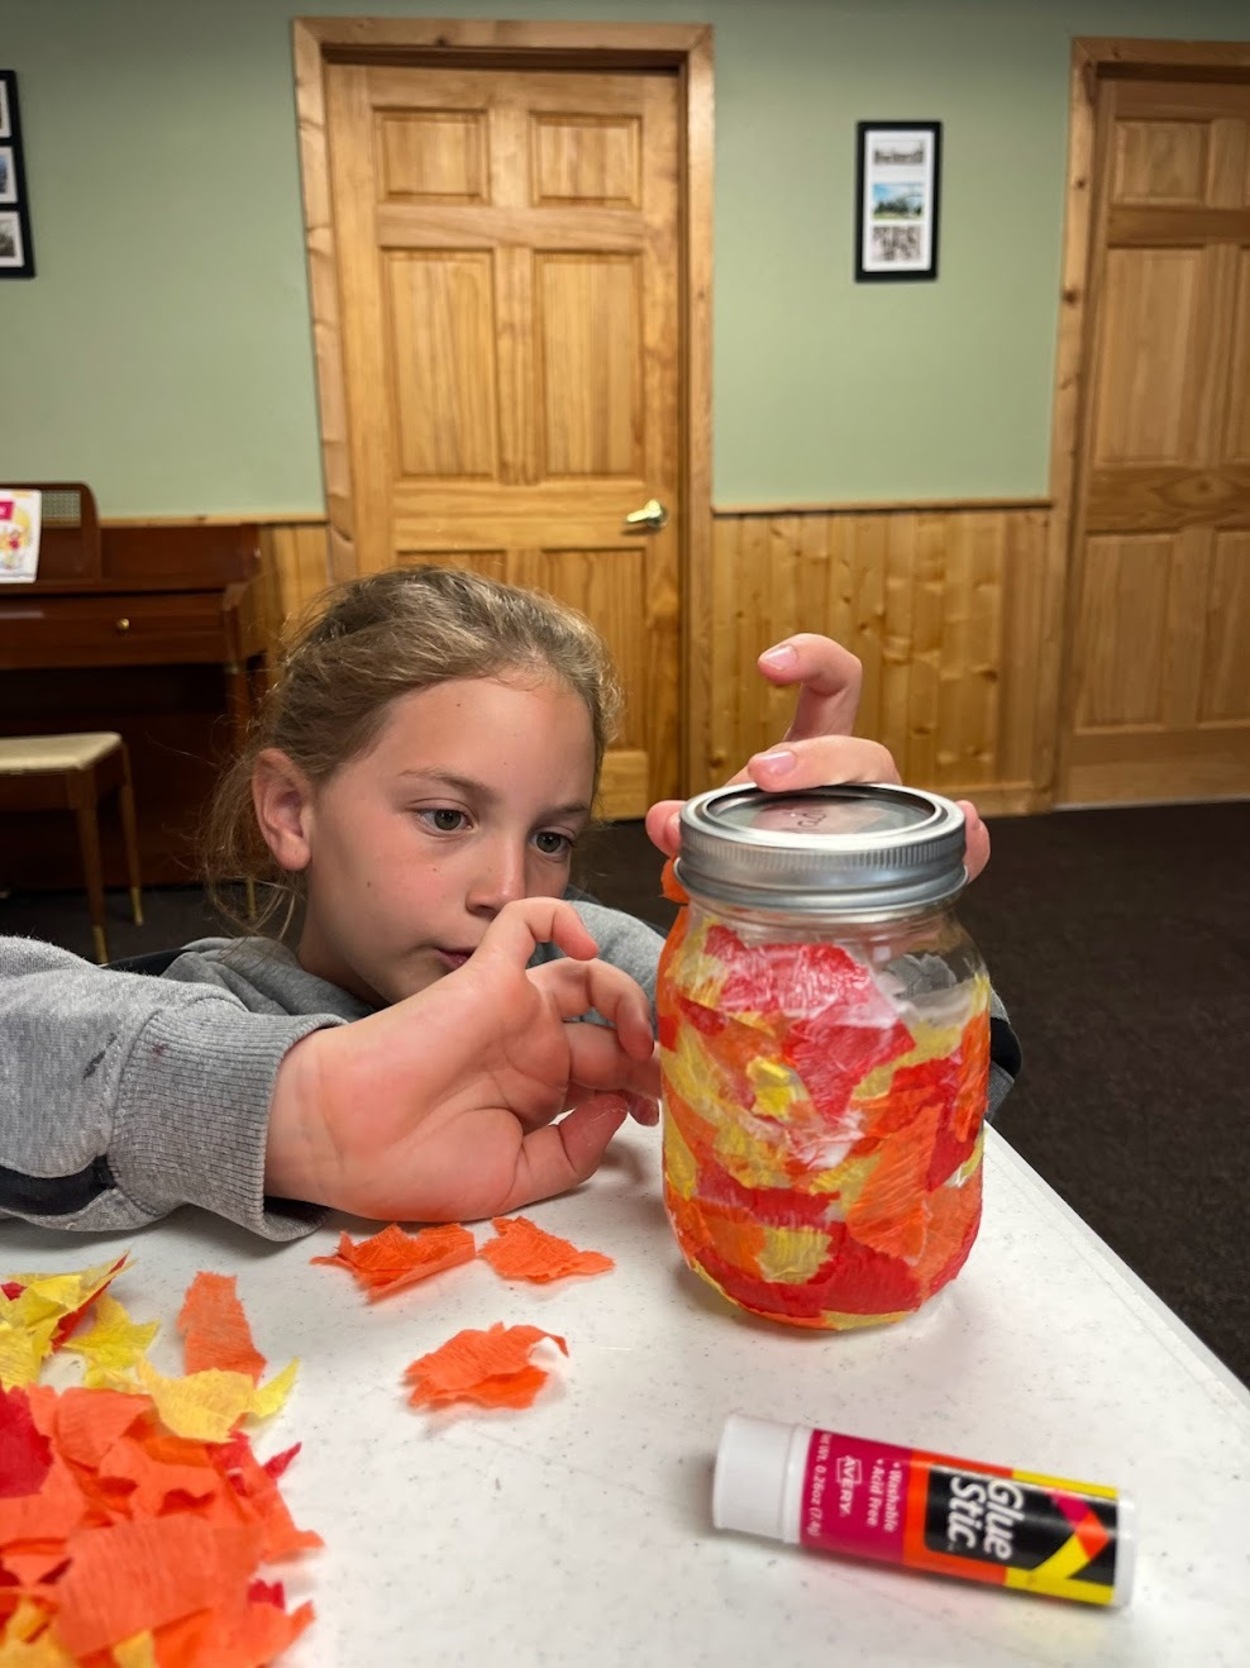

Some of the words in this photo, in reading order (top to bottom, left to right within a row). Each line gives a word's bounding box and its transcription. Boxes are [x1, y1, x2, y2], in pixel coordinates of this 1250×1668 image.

[839, 1455, 856, 1515] AVERY
[869, 1466, 885, 1496] Acid
[884, 1470, 902, 1533] Washable
[866, 1497, 882, 1527] Free
[948, 1476, 987, 1548] Stic
[984, 1480, 1024, 1560] Glue
